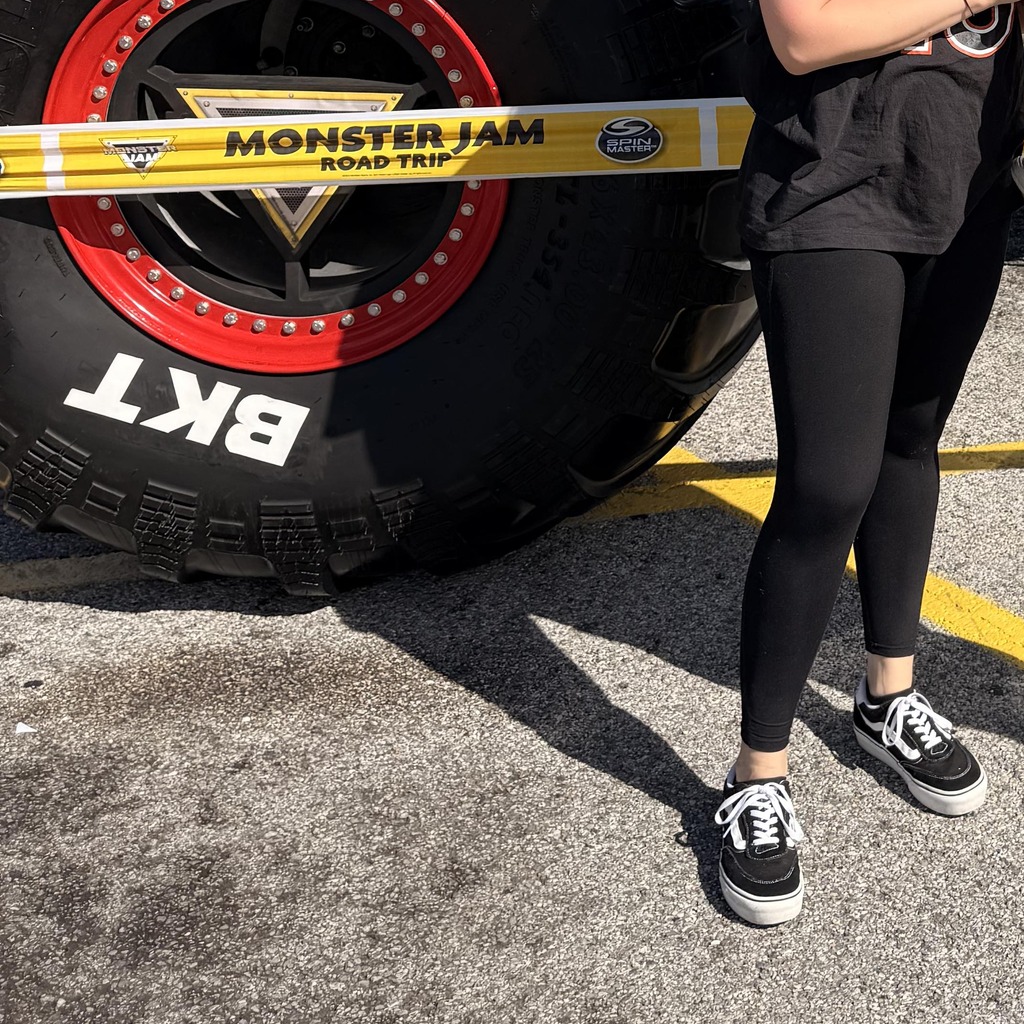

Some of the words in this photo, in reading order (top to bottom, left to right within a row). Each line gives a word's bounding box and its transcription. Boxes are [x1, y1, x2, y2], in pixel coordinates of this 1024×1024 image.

[224, 123, 444, 157] MONSTER
[451, 118, 544, 155] JAM
[607, 138, 651, 147] SPIN
[103, 145, 178, 156] MONSTER
[123, 153, 160, 163] JAM
[320, 155, 390, 171] ROAD
[396, 153, 452, 168] TRIP
[63, 352, 311, 467] BKT
